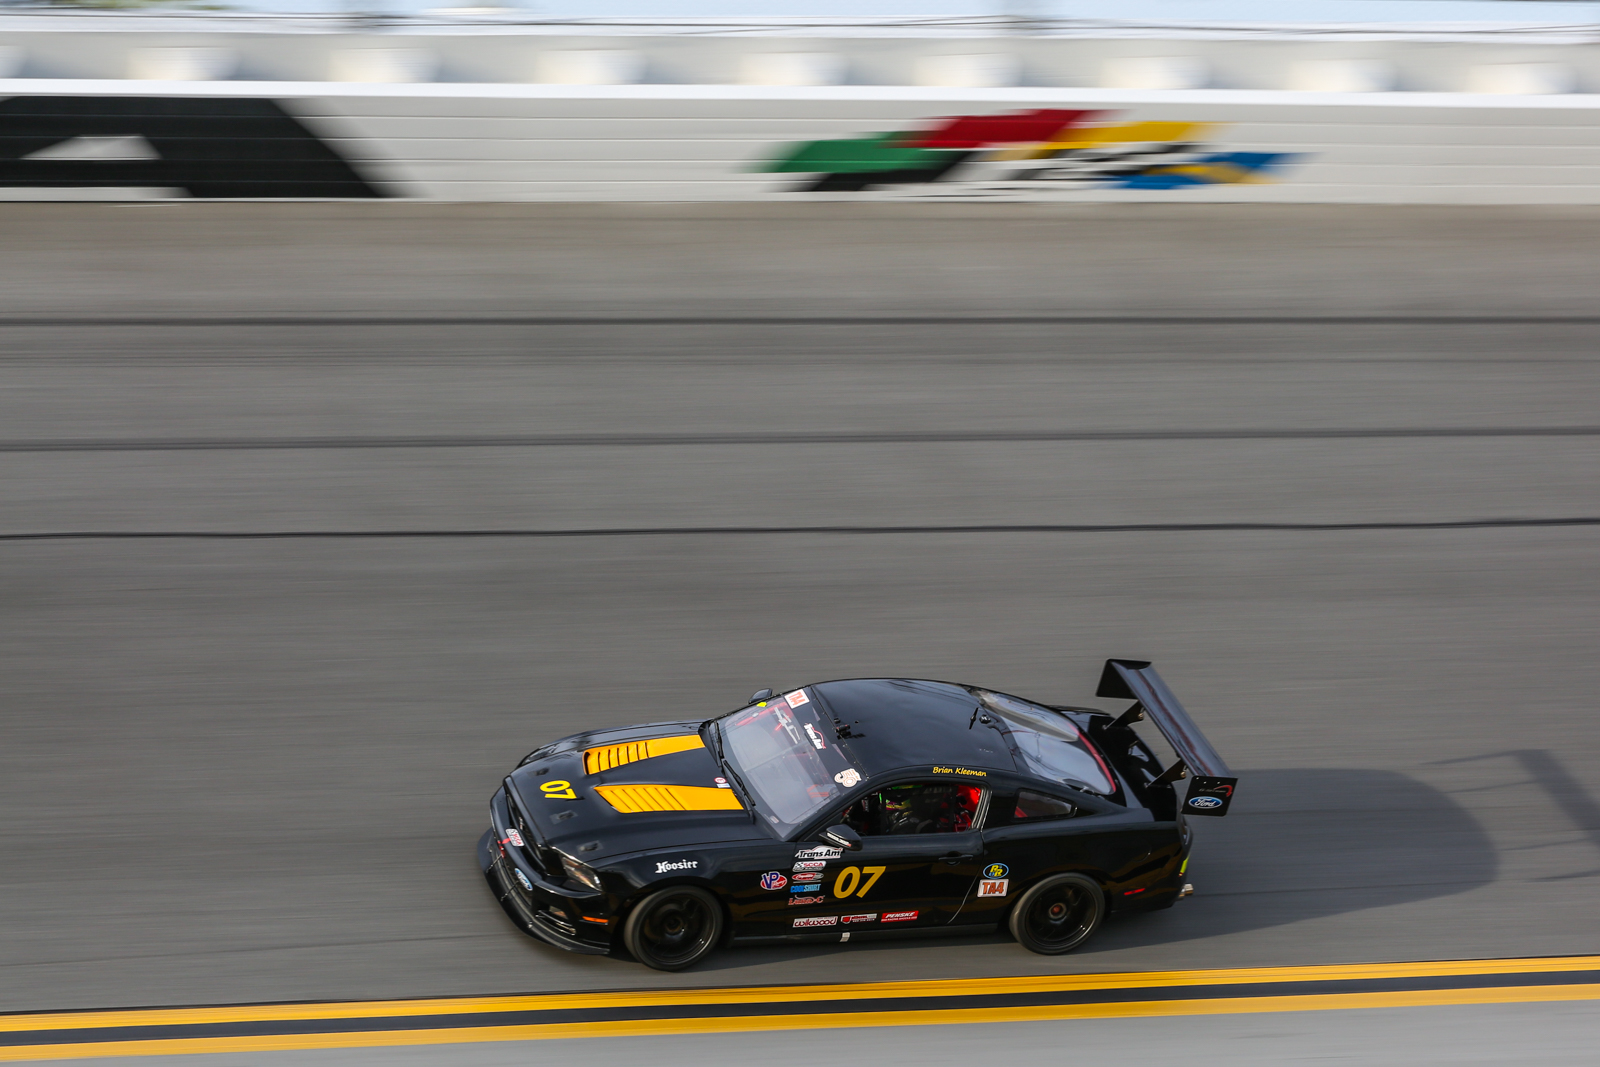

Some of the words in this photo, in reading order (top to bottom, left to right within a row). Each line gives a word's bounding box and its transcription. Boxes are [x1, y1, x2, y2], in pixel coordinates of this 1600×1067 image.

[932, 766, 953, 774] Brian
[955, 767, 987, 777] Kleeman
[540, 780, 577, 800] 07
[1194, 797, 1217, 808] Ford
[799, 850, 824, 858] Trans
[824, 849, 841, 857] Am
[655, 859, 698, 874] Hoosier
[763, 871, 780, 890] VP
[833, 866, 887, 899] 07
[982, 881, 1005, 895] TA4
[885, 911, 916, 919] PENSKE
[794, 917, 837, 927] wilwood
